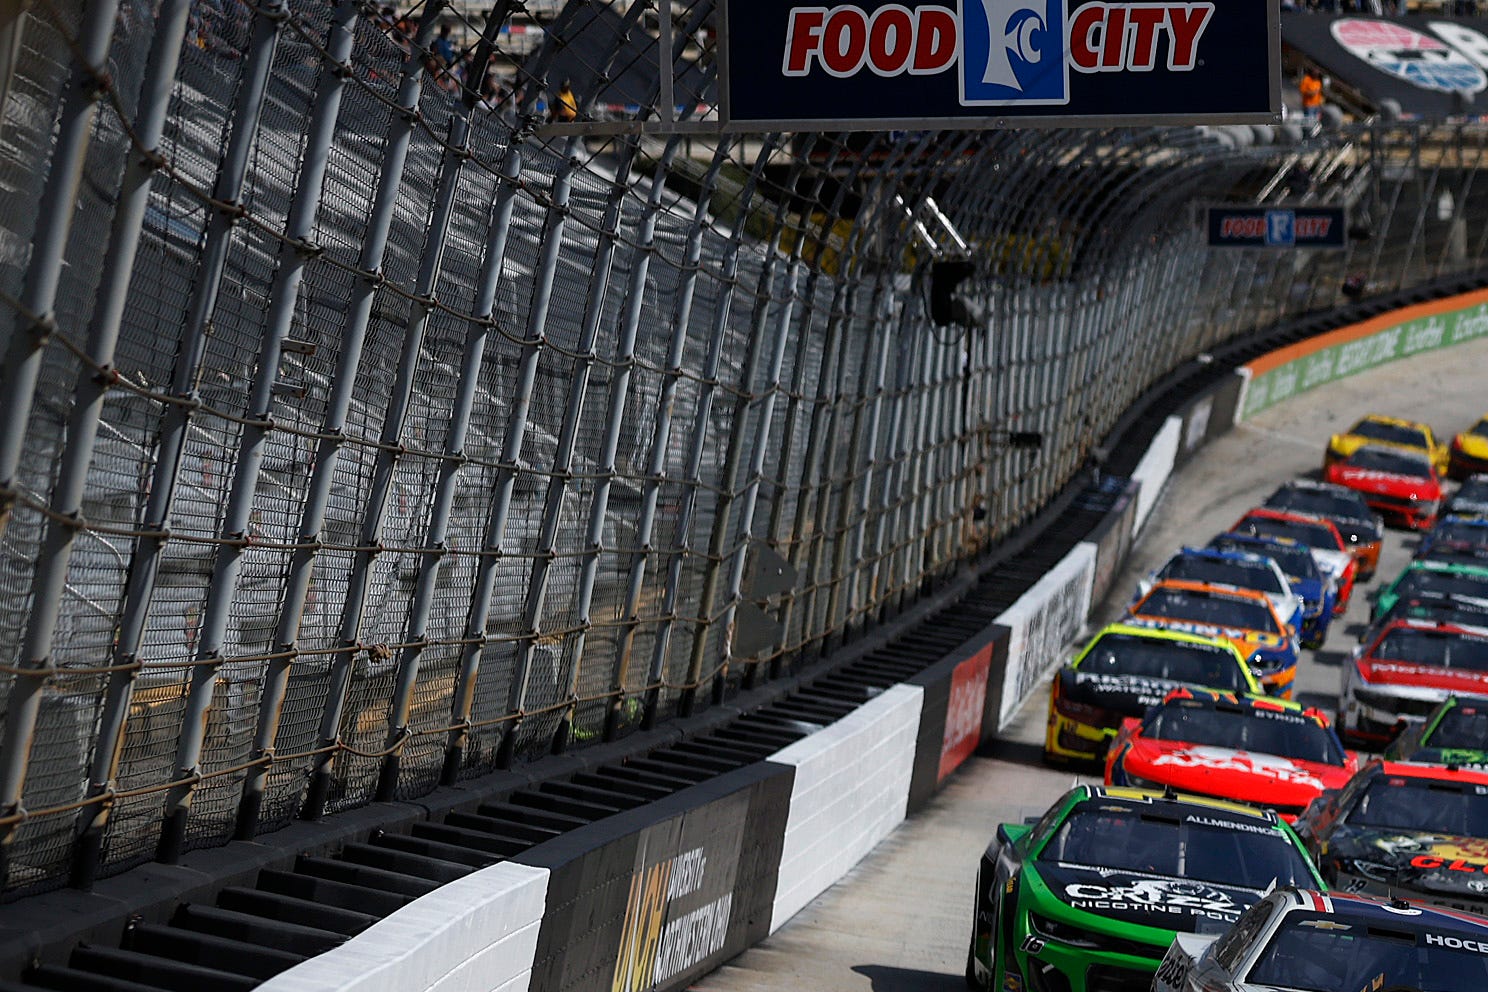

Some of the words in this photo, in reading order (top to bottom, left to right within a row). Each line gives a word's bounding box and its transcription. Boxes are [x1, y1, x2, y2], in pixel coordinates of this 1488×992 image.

[782, 4, 959, 77] FOOD
[1069, 1, 1215, 73] CITY
[1220, 216, 1267, 238] FOOD
[1295, 216, 1333, 238] CITY
[1255, 708, 1306, 725] BYRON
[1152, 753, 1326, 791] AXALTA
[1064, 879, 1255, 915] GRIZZ
[1071, 900, 1182, 914] NICOTINE
[1019, 933, 1045, 955] 16
